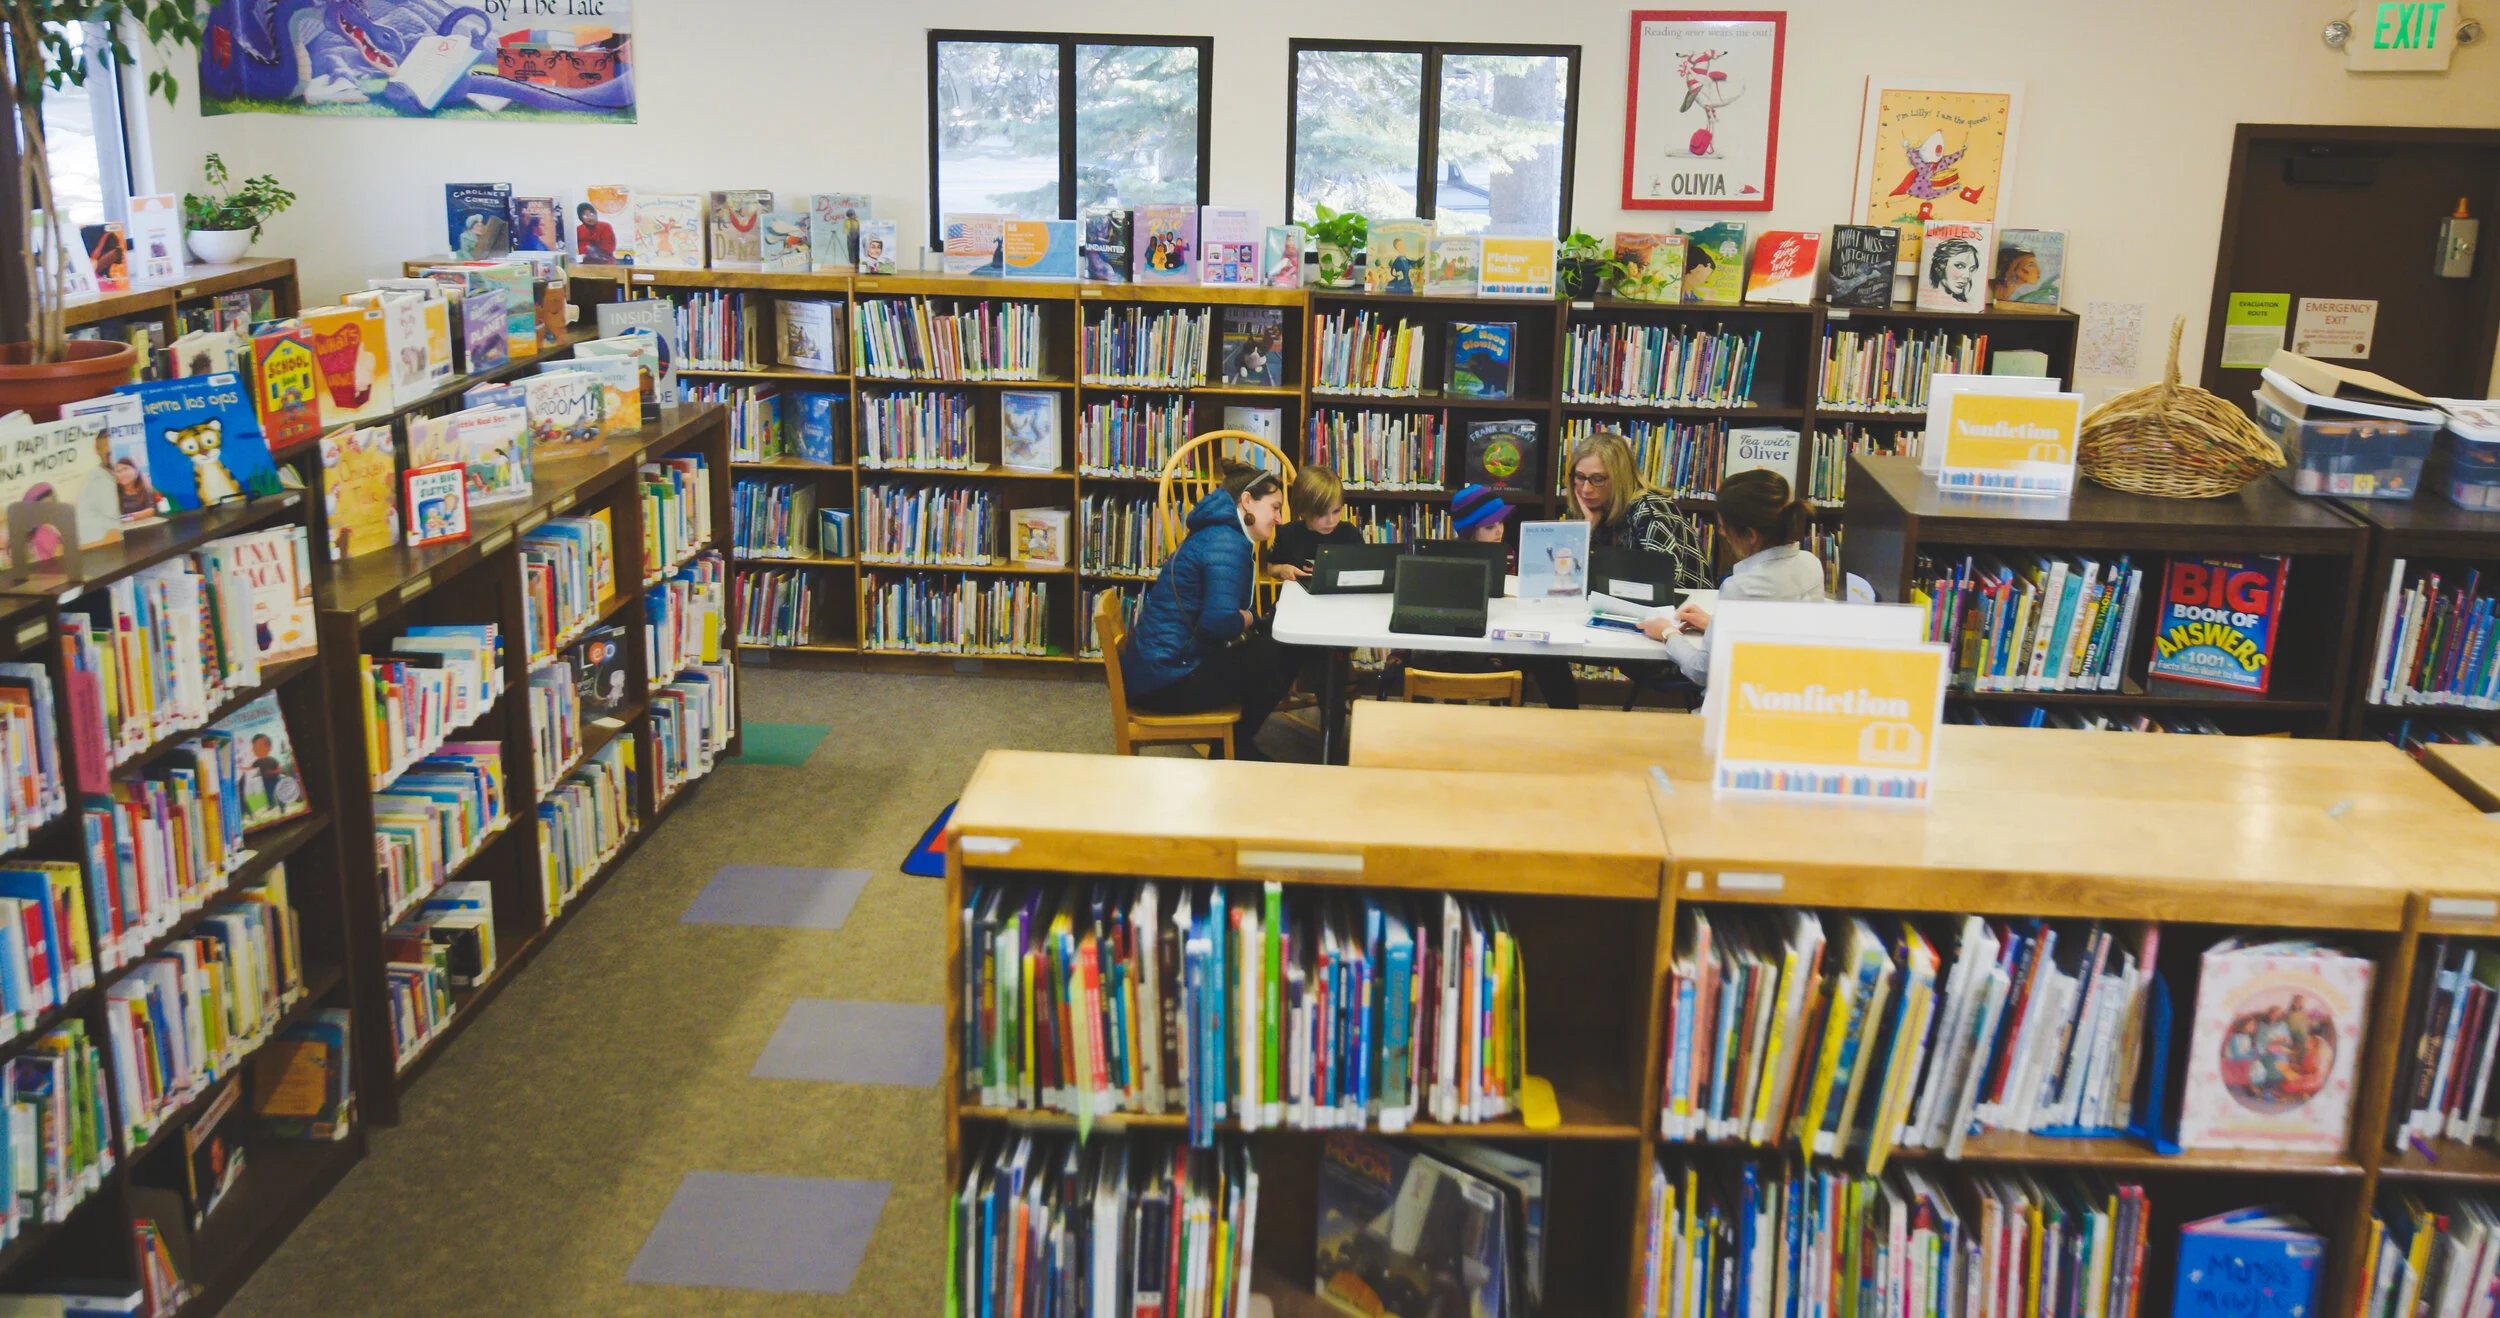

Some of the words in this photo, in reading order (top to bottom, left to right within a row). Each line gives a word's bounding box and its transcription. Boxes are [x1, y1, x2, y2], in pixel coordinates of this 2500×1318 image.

[1644, 26, 1682, 39] Reading
[1708, 29, 1733, 37] wears
[1752, 27, 1773, 37] out!
[2373, 2, 2446, 49] EXIT
[1954, 115, 1965, 125] the
[1671, 173, 1726, 196] OLIVIA
[1837, 229, 1861, 250] WHAT
[1863, 231, 1883, 253] MISS
[1925, 222, 1984, 242] LIMITLESS
[1086, 243, 1126, 254] UNDAUNTED
[1487, 252, 1529, 263] Picture
[1840, 248, 1880, 265] MITCHELL
[1487, 263, 1521, 274] Books
[1840, 262, 1859, 278] SAW
[2305, 302, 2372, 314] EMERGENCY
[611, 310, 664, 326] INSIDE
[2325, 315, 2348, 325] EXIT
[268, 356, 310, 379] SCHOOL
[183, 393, 206, 410] los
[210, 387, 239, 412] ojos
[534, 393, 596, 417] VROOM!
[1469, 425, 1498, 443] FRANK
[1955, 418, 2060, 441] Nonfiction
[16, 437, 48, 458] PAPI
[53, 424, 86, 444] TIEN
[1740, 434, 1761, 446] Tea
[1763, 438, 1792, 447] with
[32, 448, 78, 471] MOTO
[1739, 445, 1790, 461] Oliver
[440, 472, 457, 483] BIG
[420, 484, 456, 498] SISTER
[233, 540, 280, 568] UNA
[2169, 561, 2271, 616] BIG
[2173, 603, 2231, 625] BOOK
[2230, 612, 2260, 629] OF
[2155, 622, 2269, 672] ANSWERS
[2187, 651, 2226, 668] 1001
[2157, 659, 2181, 671] Facts
[2181, 663, 2200, 674] Kids
[2200, 666, 2222, 678] Want
[2222, 670, 2233, 679] to
[2232, 670, 2258, 684] Know
[1737, 681, 1911, 719] Nonfiction
